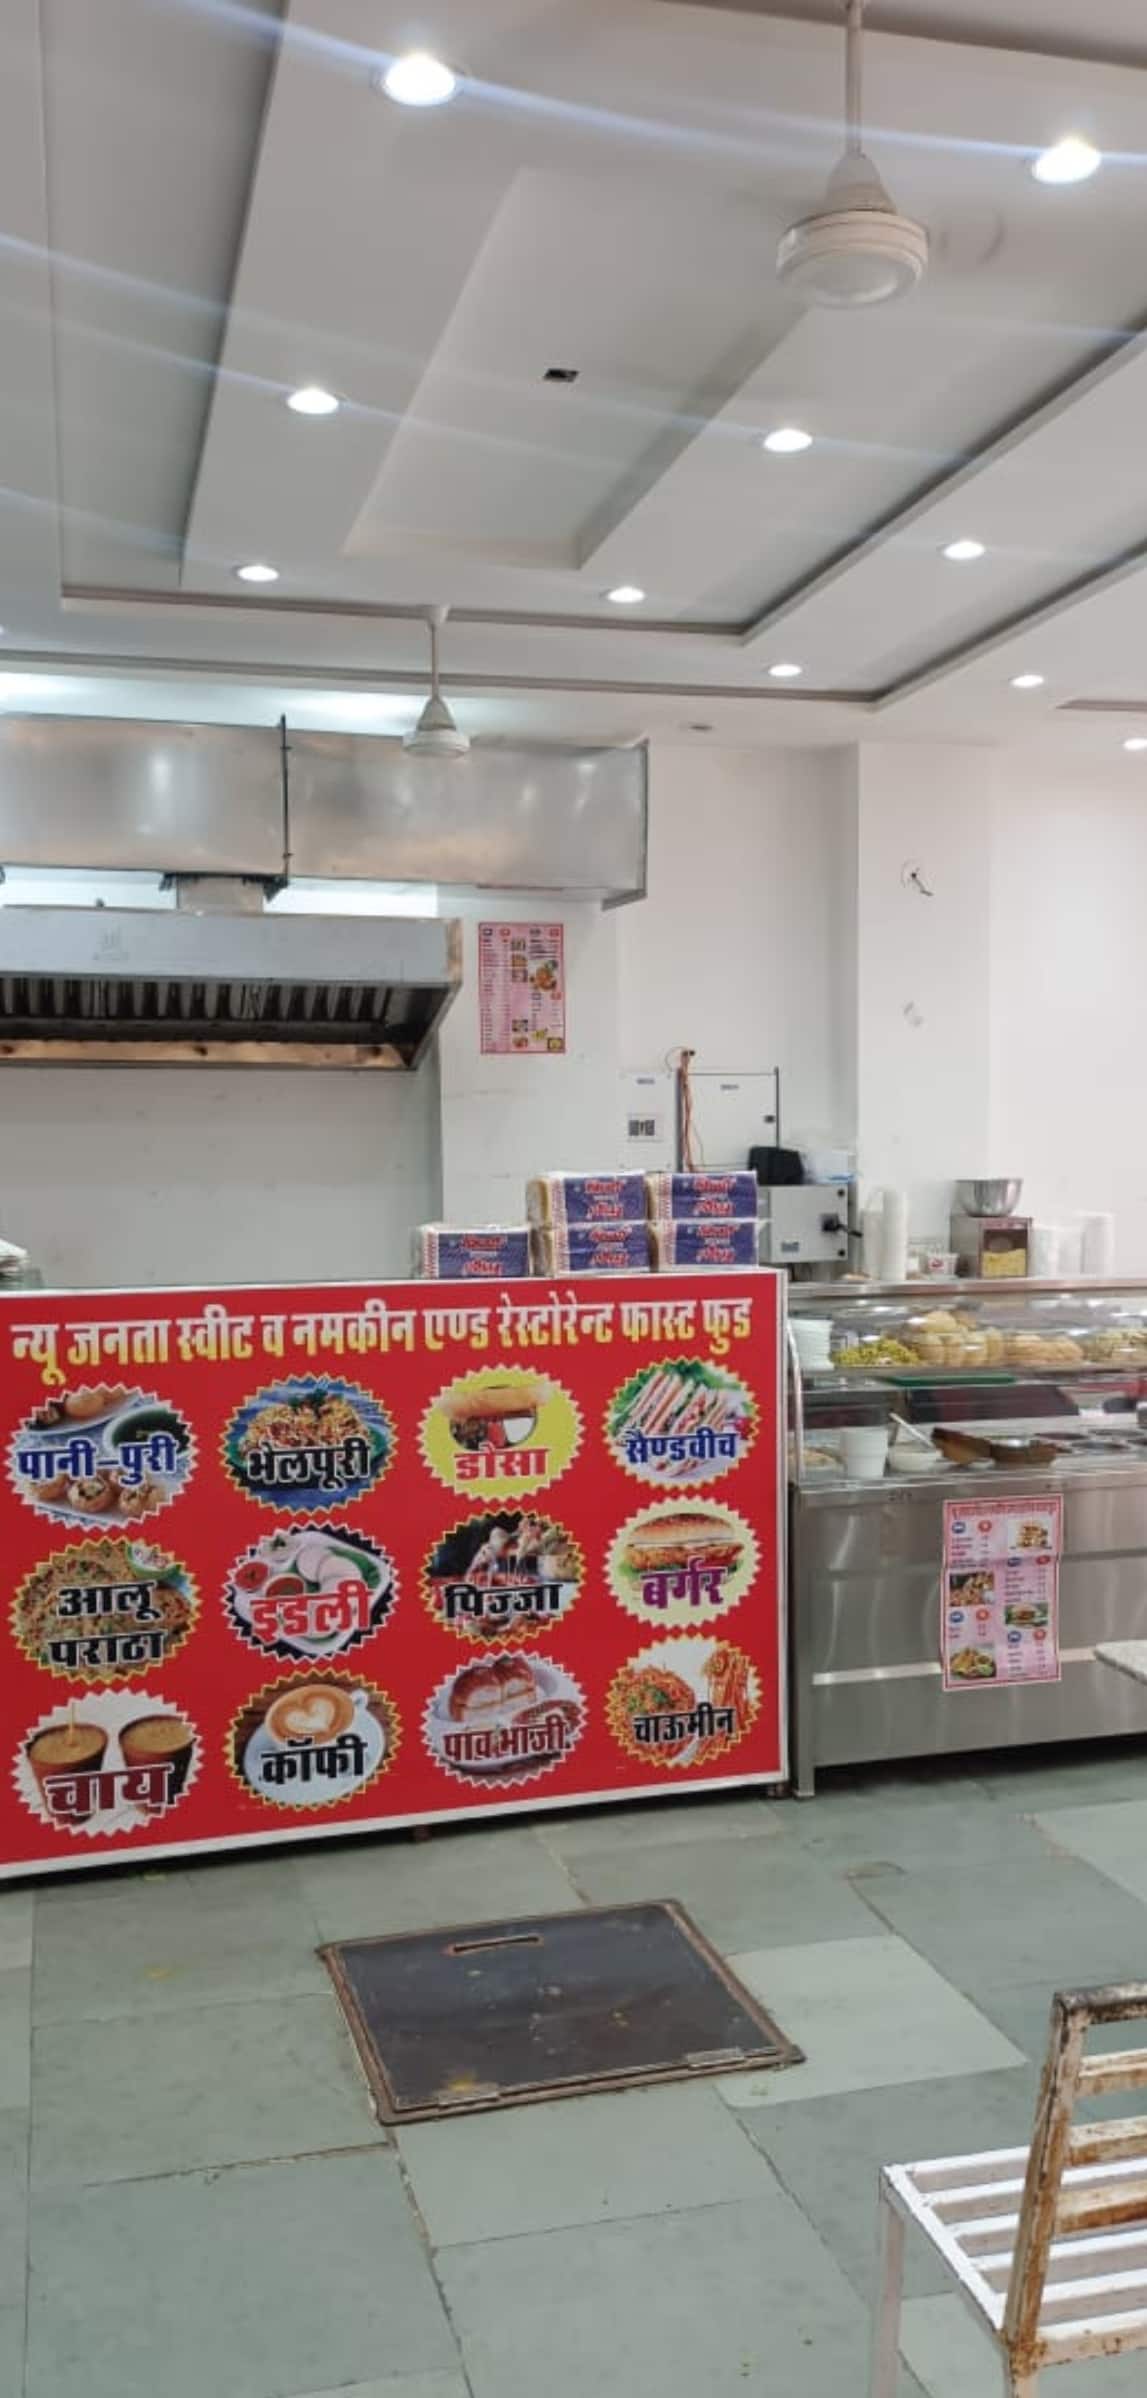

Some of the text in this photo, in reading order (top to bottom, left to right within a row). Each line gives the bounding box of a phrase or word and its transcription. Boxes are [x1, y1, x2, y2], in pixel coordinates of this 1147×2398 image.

[10, 1290, 753, 1386] न्यू जनता स्वीट व नमकीन एण्ड रेस्टोरेन्ट फास्ट फुड
[249, 1437, 370, 1490] भेलपूरी
[57, 1582, 161, 1620] आलू
[444, 1583, 563, 1619] पिज्जा
[640, 1556, 727, 1610] बर्गर
[250, 1579, 374, 1644] इडली
[48, 1631, 165, 1668] पराठा
[633, 1701, 735, 1743] चाऊमीन
[260, 1733, 368, 1785] कॉफी
[45, 1765, 174, 1814] चाय
